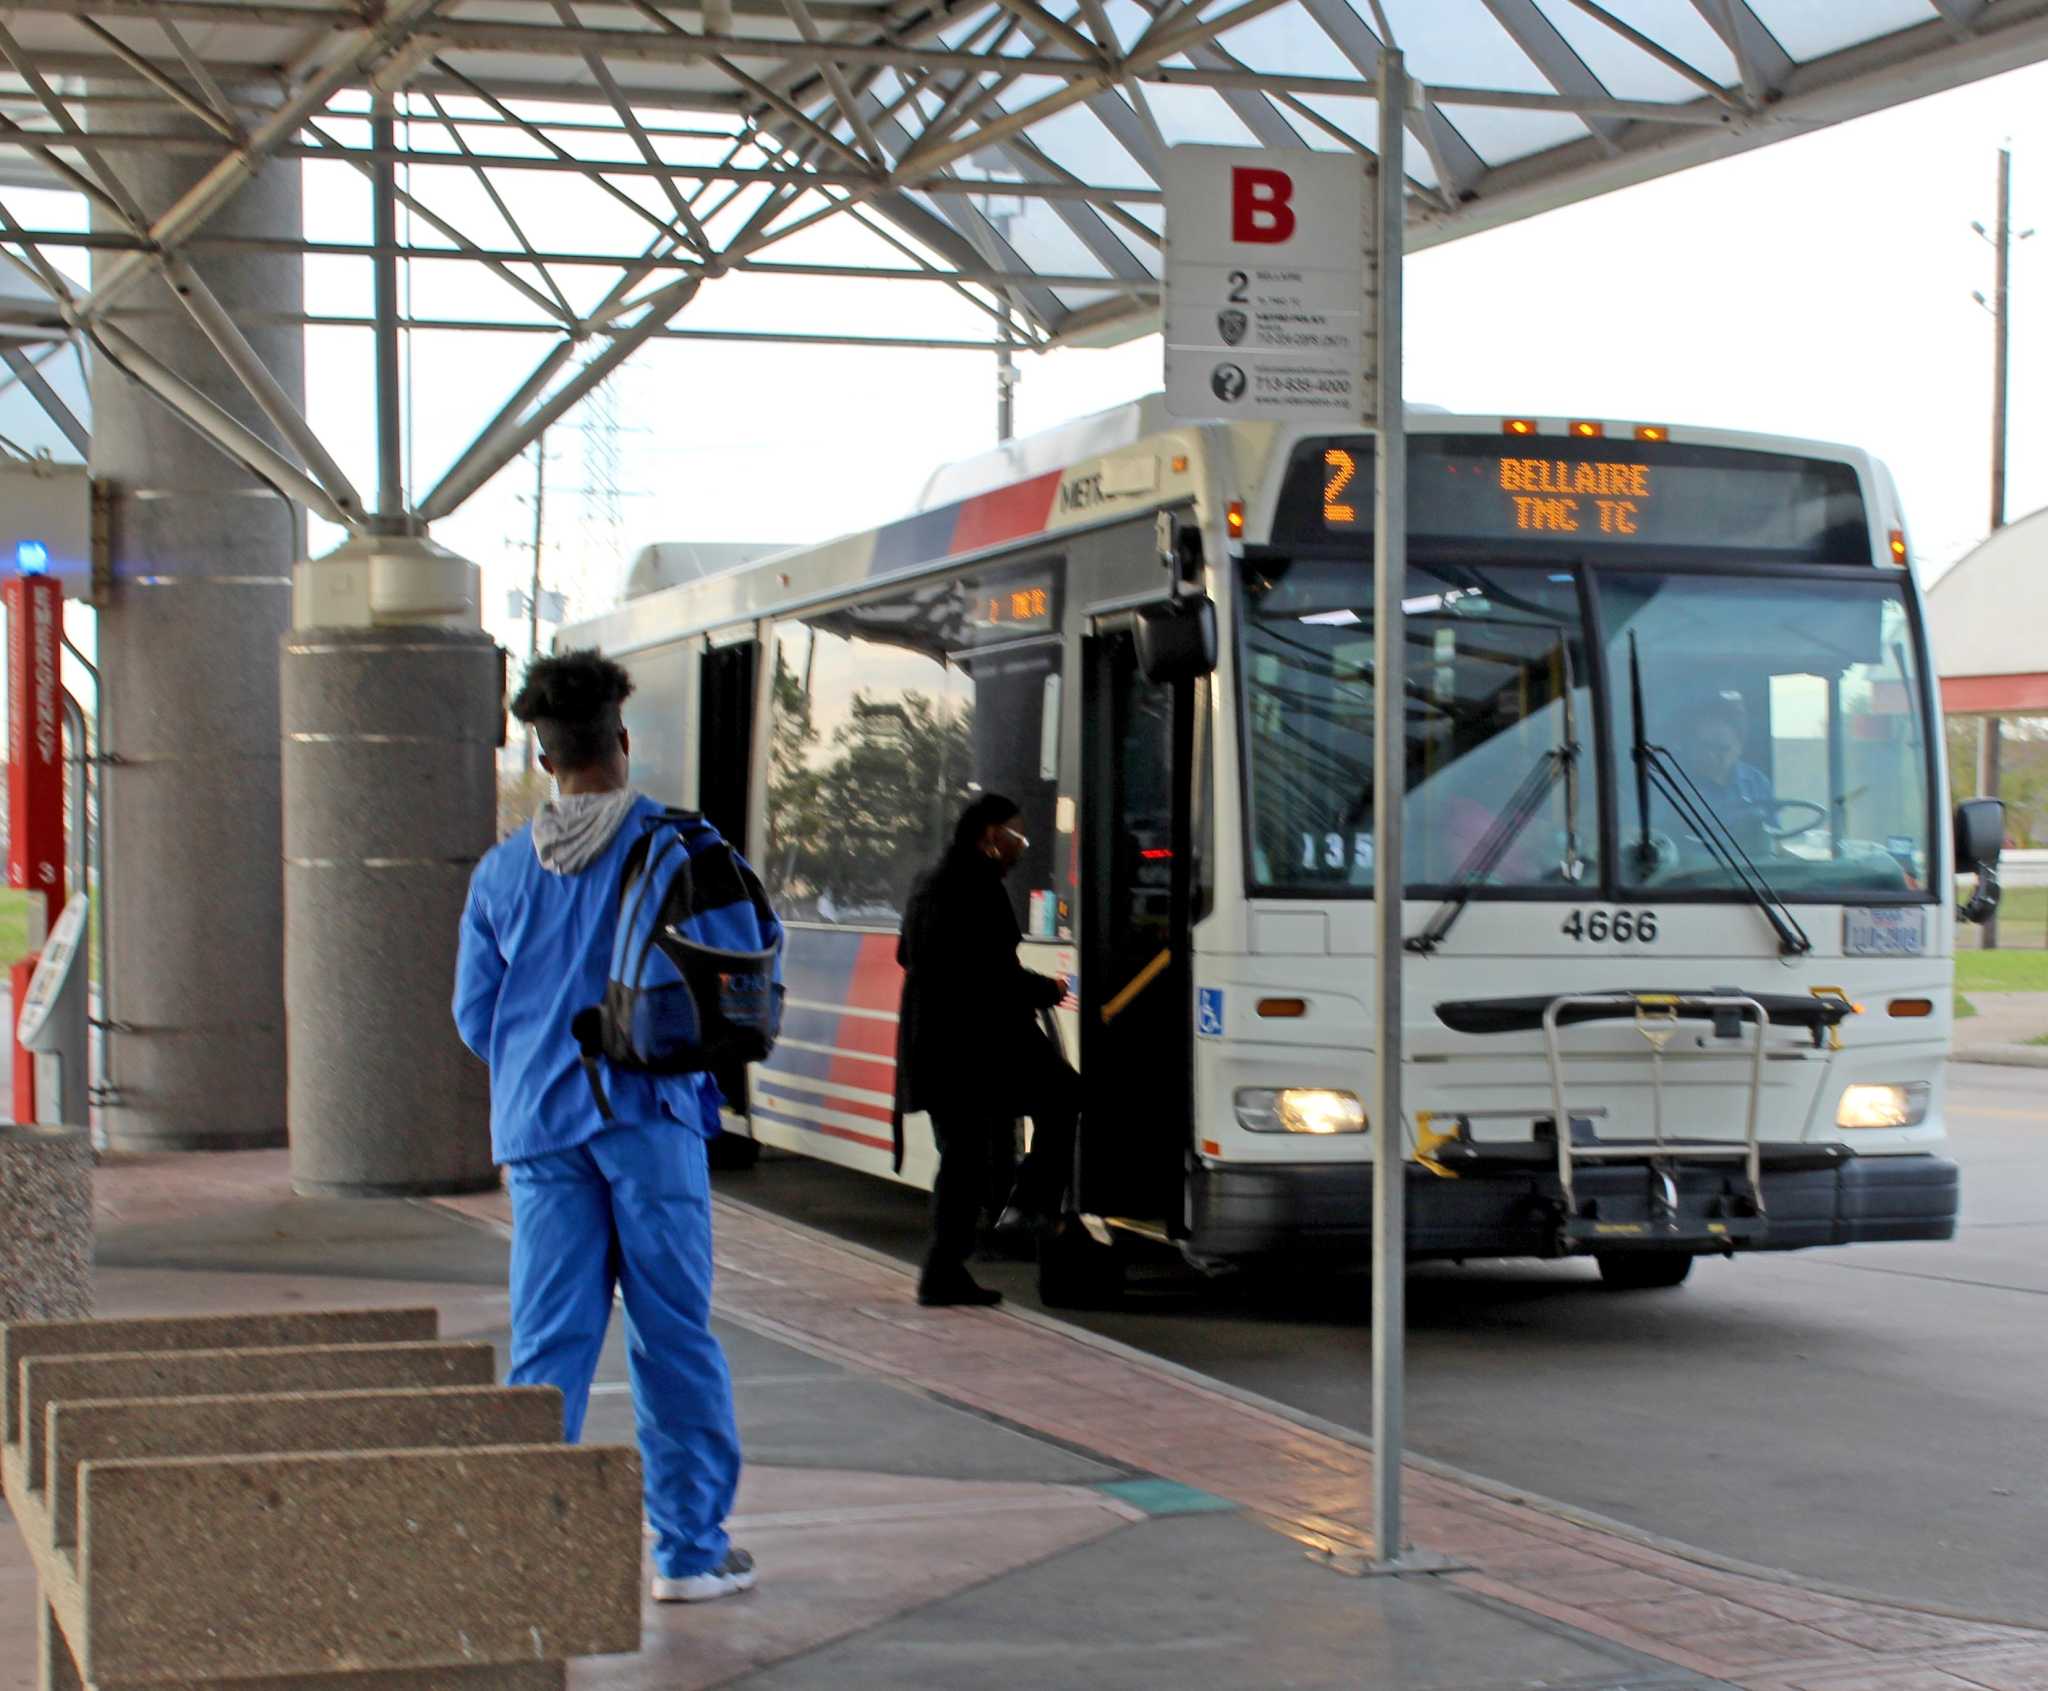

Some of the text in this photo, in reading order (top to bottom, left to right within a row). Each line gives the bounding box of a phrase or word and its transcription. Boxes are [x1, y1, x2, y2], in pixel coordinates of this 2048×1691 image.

[1231, 166, 1296, 244] B
[1228, 270, 1249, 304] 2
[1323, 449, 1356, 522] 2
[1499, 457, 1649, 497] BELLAIRE
[1513, 496, 1637, 534] TMC TC
[1561, 910, 1658, 943] 4666
